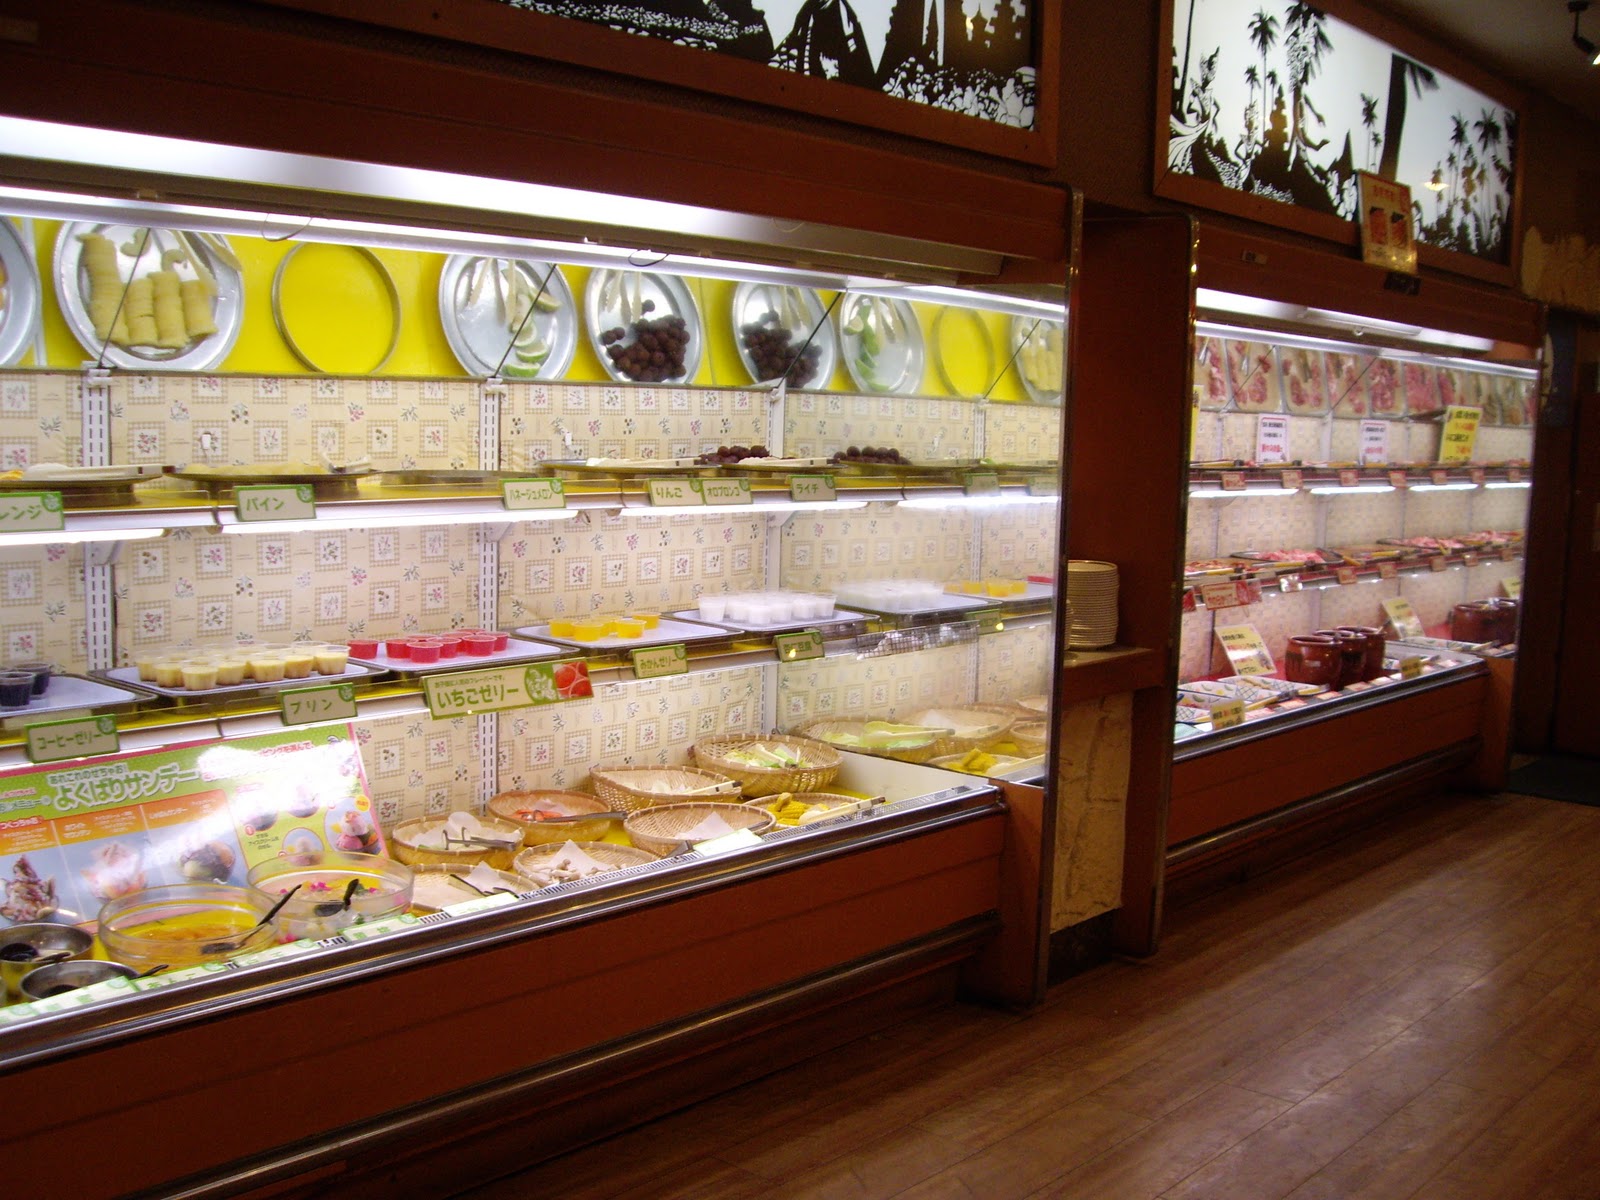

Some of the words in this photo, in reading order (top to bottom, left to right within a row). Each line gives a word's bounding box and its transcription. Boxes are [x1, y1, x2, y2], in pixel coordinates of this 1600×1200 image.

[796, 483, 819, 494] ライチ
[437, 684, 519, 708] いちごゼリー
[37, 732, 101, 750] コーヒーゼリー
[55, 764, 200, 810] よくばりサンデー
